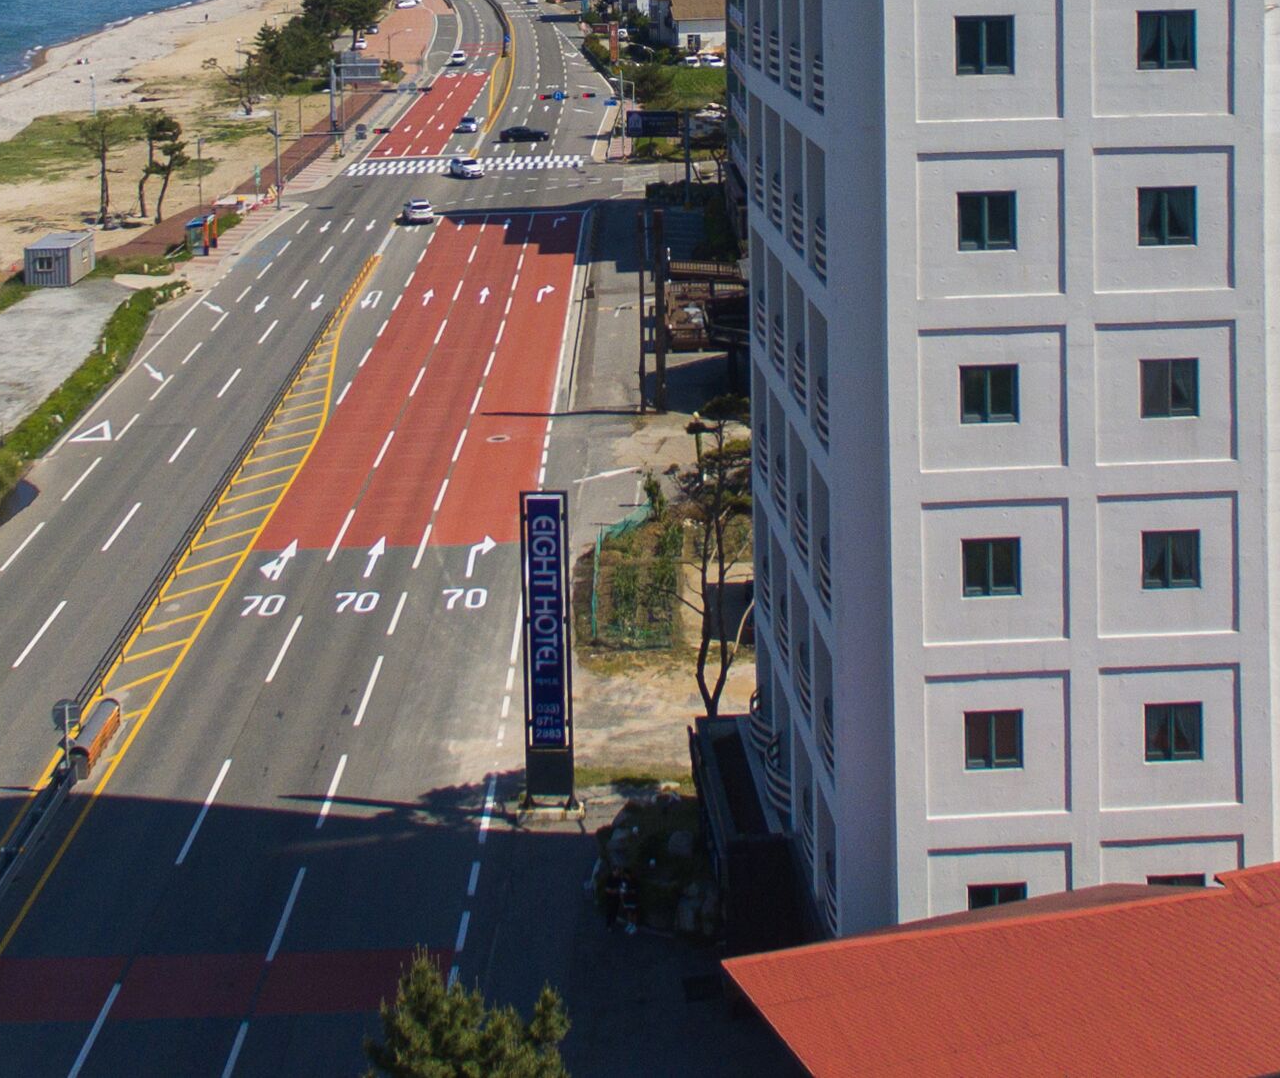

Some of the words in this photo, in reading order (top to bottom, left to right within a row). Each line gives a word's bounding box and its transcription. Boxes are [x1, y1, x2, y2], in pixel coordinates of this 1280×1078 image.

[532, 515, 557, 591] EIGHT
[240, 594, 286, 617] 70
[335, 591, 380, 613] 70
[442, 587, 488, 610] 70
[534, 596, 559, 671] HOTEL
[535, 703, 560, 714] 033)
